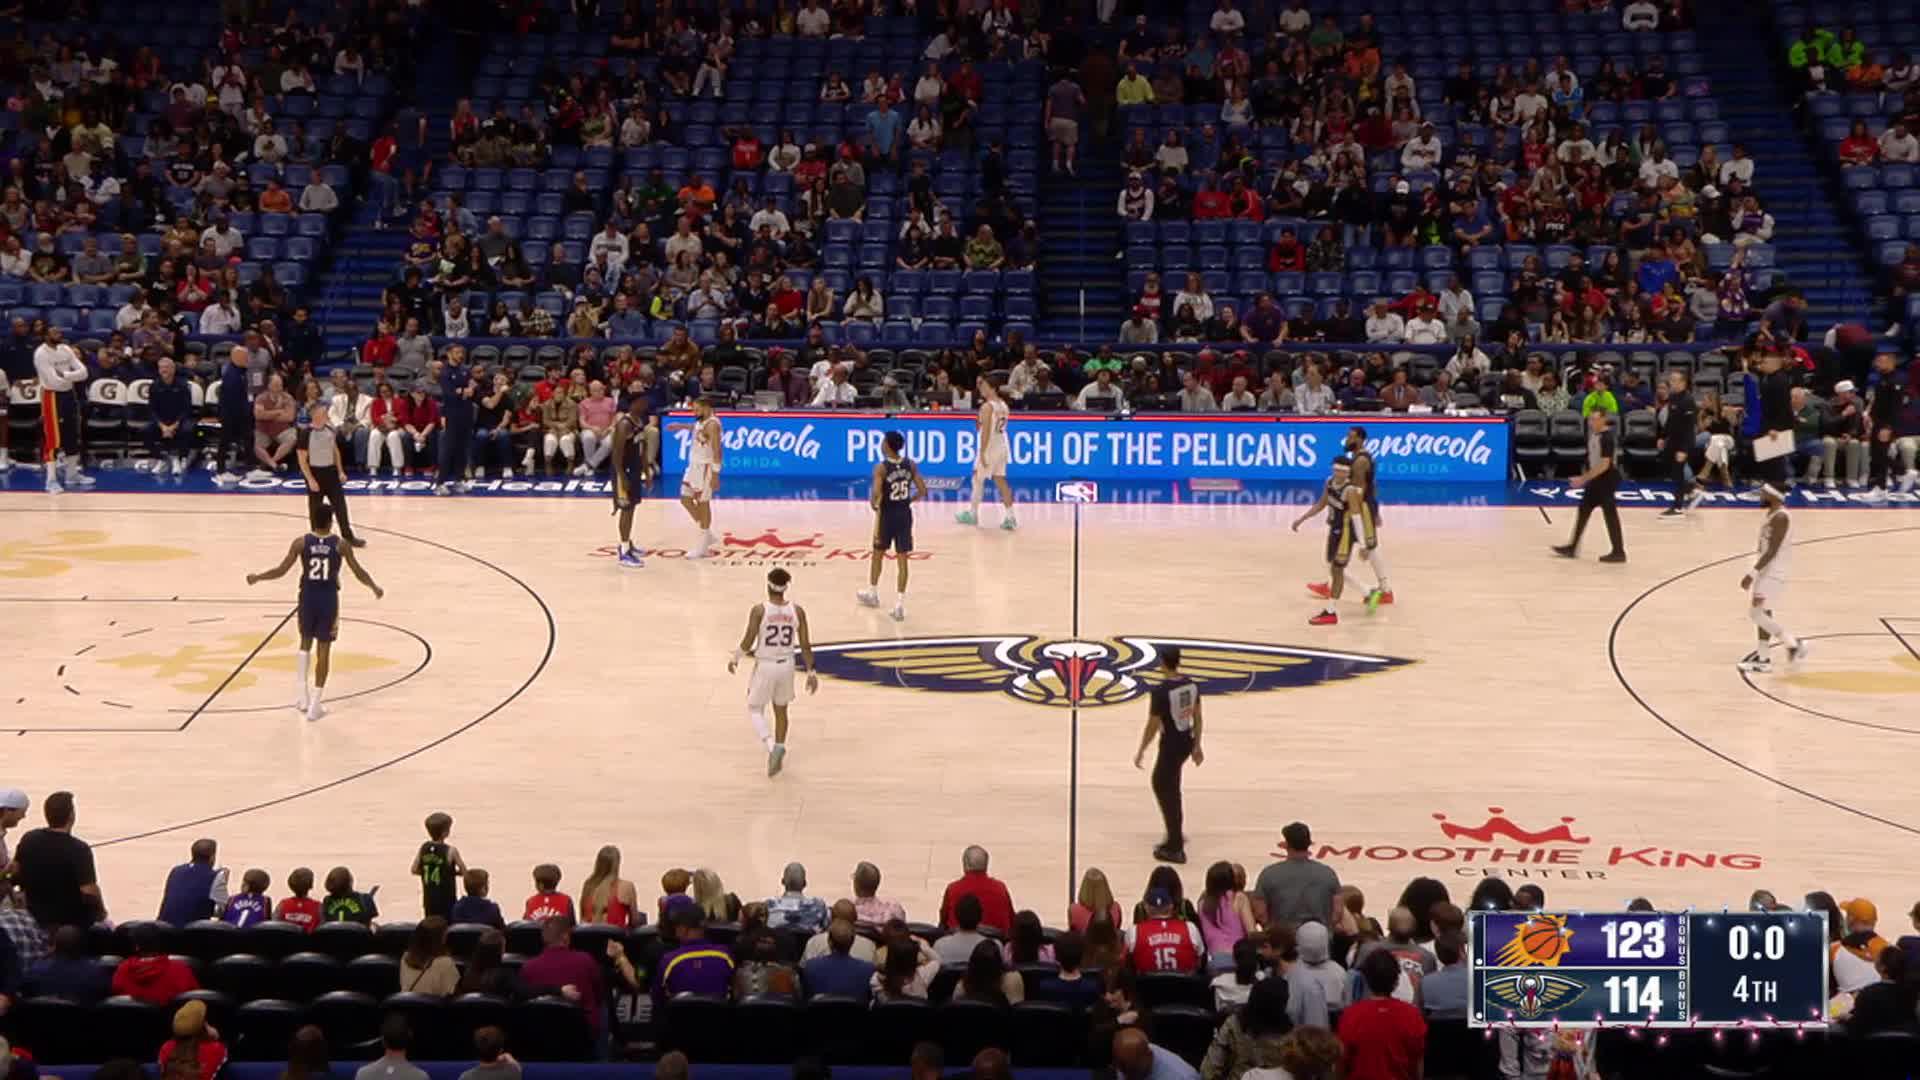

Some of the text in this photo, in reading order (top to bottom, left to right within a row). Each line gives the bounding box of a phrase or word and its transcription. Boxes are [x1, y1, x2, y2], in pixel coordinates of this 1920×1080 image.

[100, 382, 117, 399] G
[674, 424, 821, 460] Pnsacola
[848, 429, 946, 464] PRUD
[1063, 431, 1100, 465] OF
[1107, 431, 1162, 465] THE
[1172, 432, 1317, 467] PELICANS
[1341, 429, 1492, 465] ensacola
[1377, 462, 1449, 474] FLORIDA
[238, 476, 455, 490] Ocsner
[890, 480, 909, 501] 25
[309, 557, 330, 580] 21
[765, 624, 793, 646] 23
[1269, 840, 1584, 863] MOOTHIE
[423, 864, 441, 886] 14
[1455, 867, 1607, 881] CENTER
[1154, 946, 1178, 970] 15
